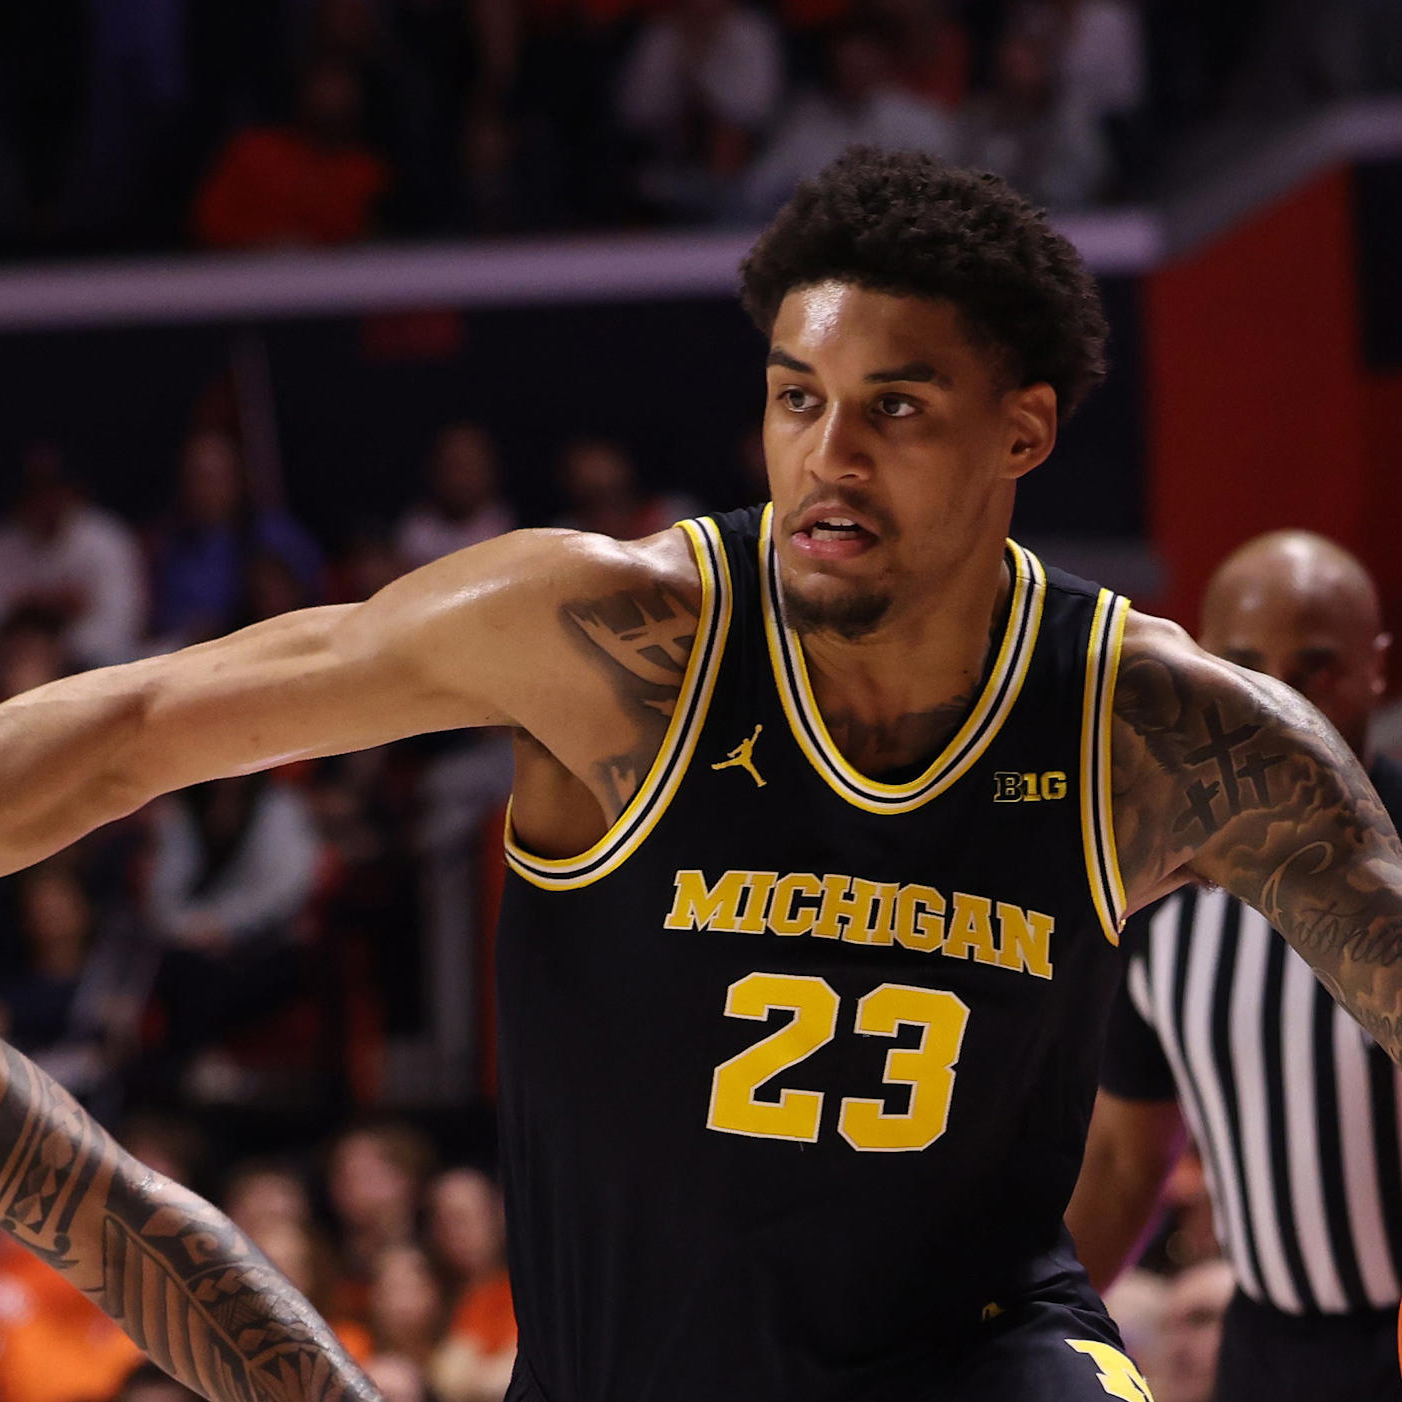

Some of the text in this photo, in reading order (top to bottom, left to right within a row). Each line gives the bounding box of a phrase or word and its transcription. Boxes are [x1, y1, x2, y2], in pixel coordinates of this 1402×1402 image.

[993, 771, 1069, 804] B1G
[663, 869, 1055, 980] MICHIGAN
[706, 971, 971, 1153] 23
